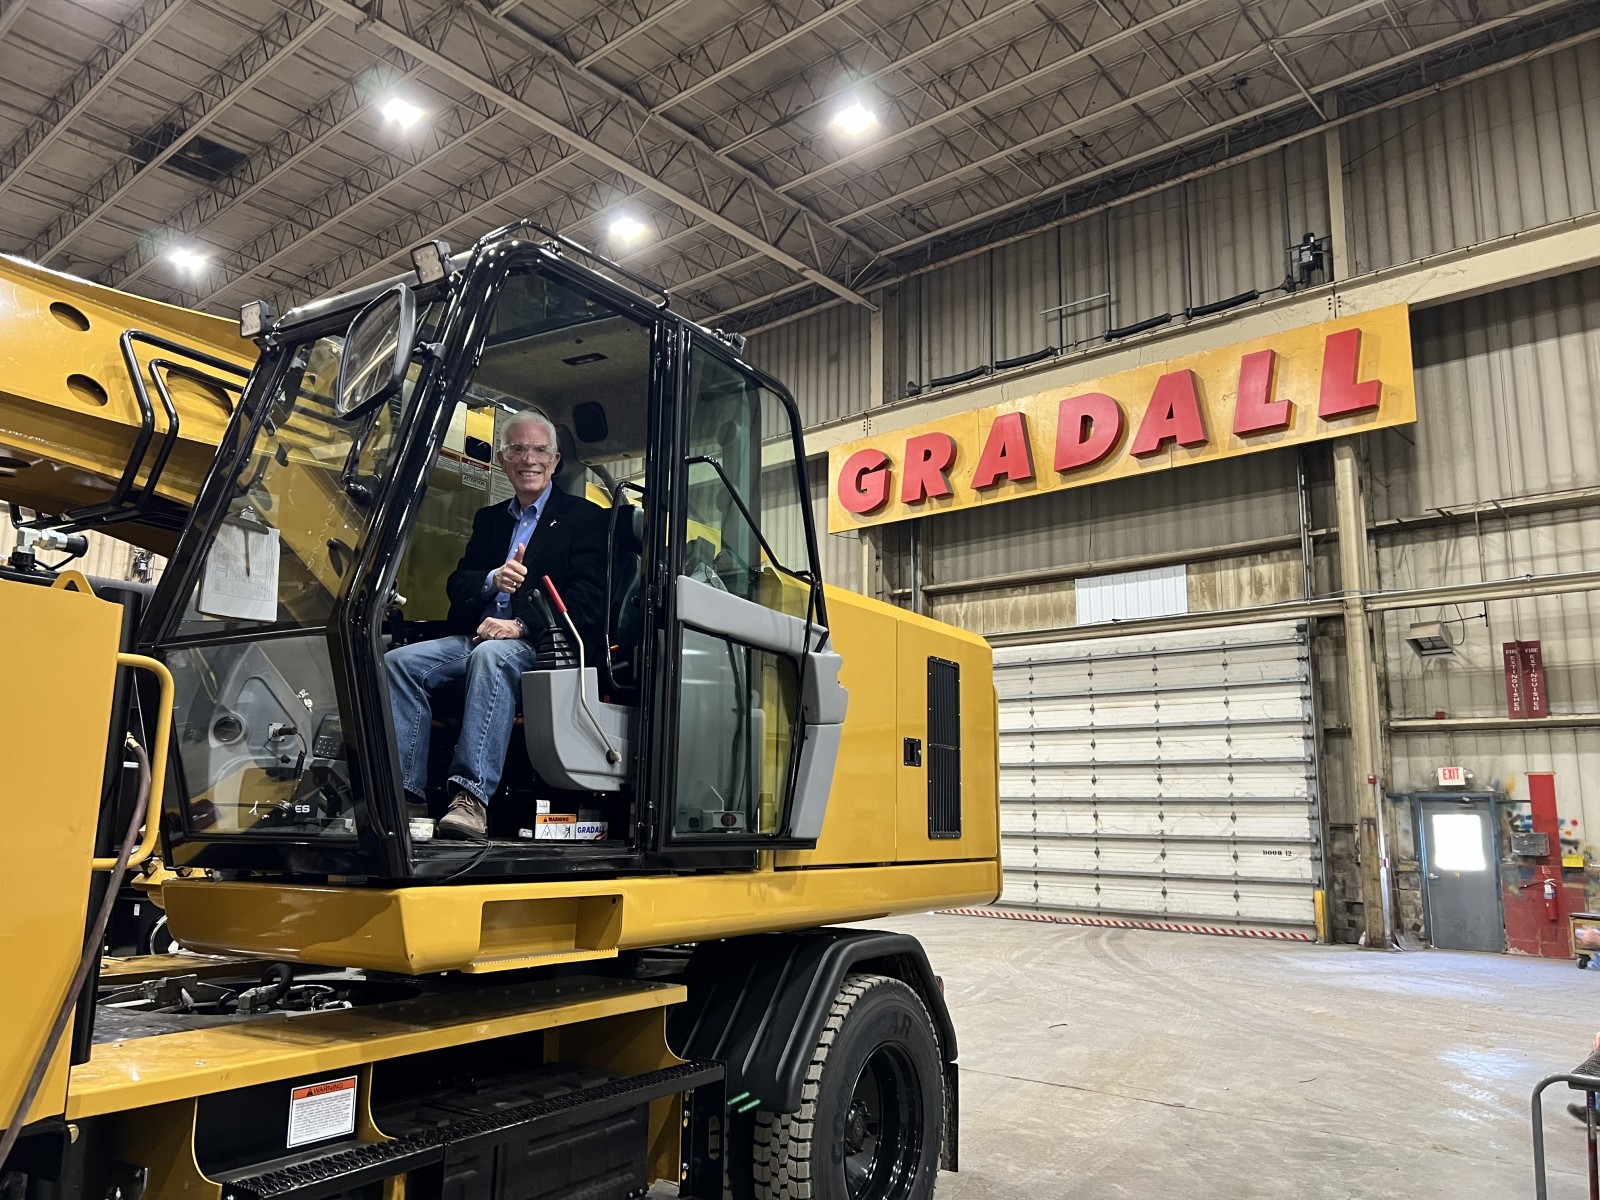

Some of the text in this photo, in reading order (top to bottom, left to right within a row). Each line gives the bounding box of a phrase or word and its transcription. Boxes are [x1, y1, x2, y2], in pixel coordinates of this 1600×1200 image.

[837, 327, 1382, 515] GRADALL
[1510, 655, 1520, 711] EXTINGUISHER
[1529, 654, 1540, 711] EXTINGUISHER
[1442, 768, 1459, 780] EXIT
[577, 825, 606, 834] GRADALL
[313, 1083, 344, 1094] WARNING
